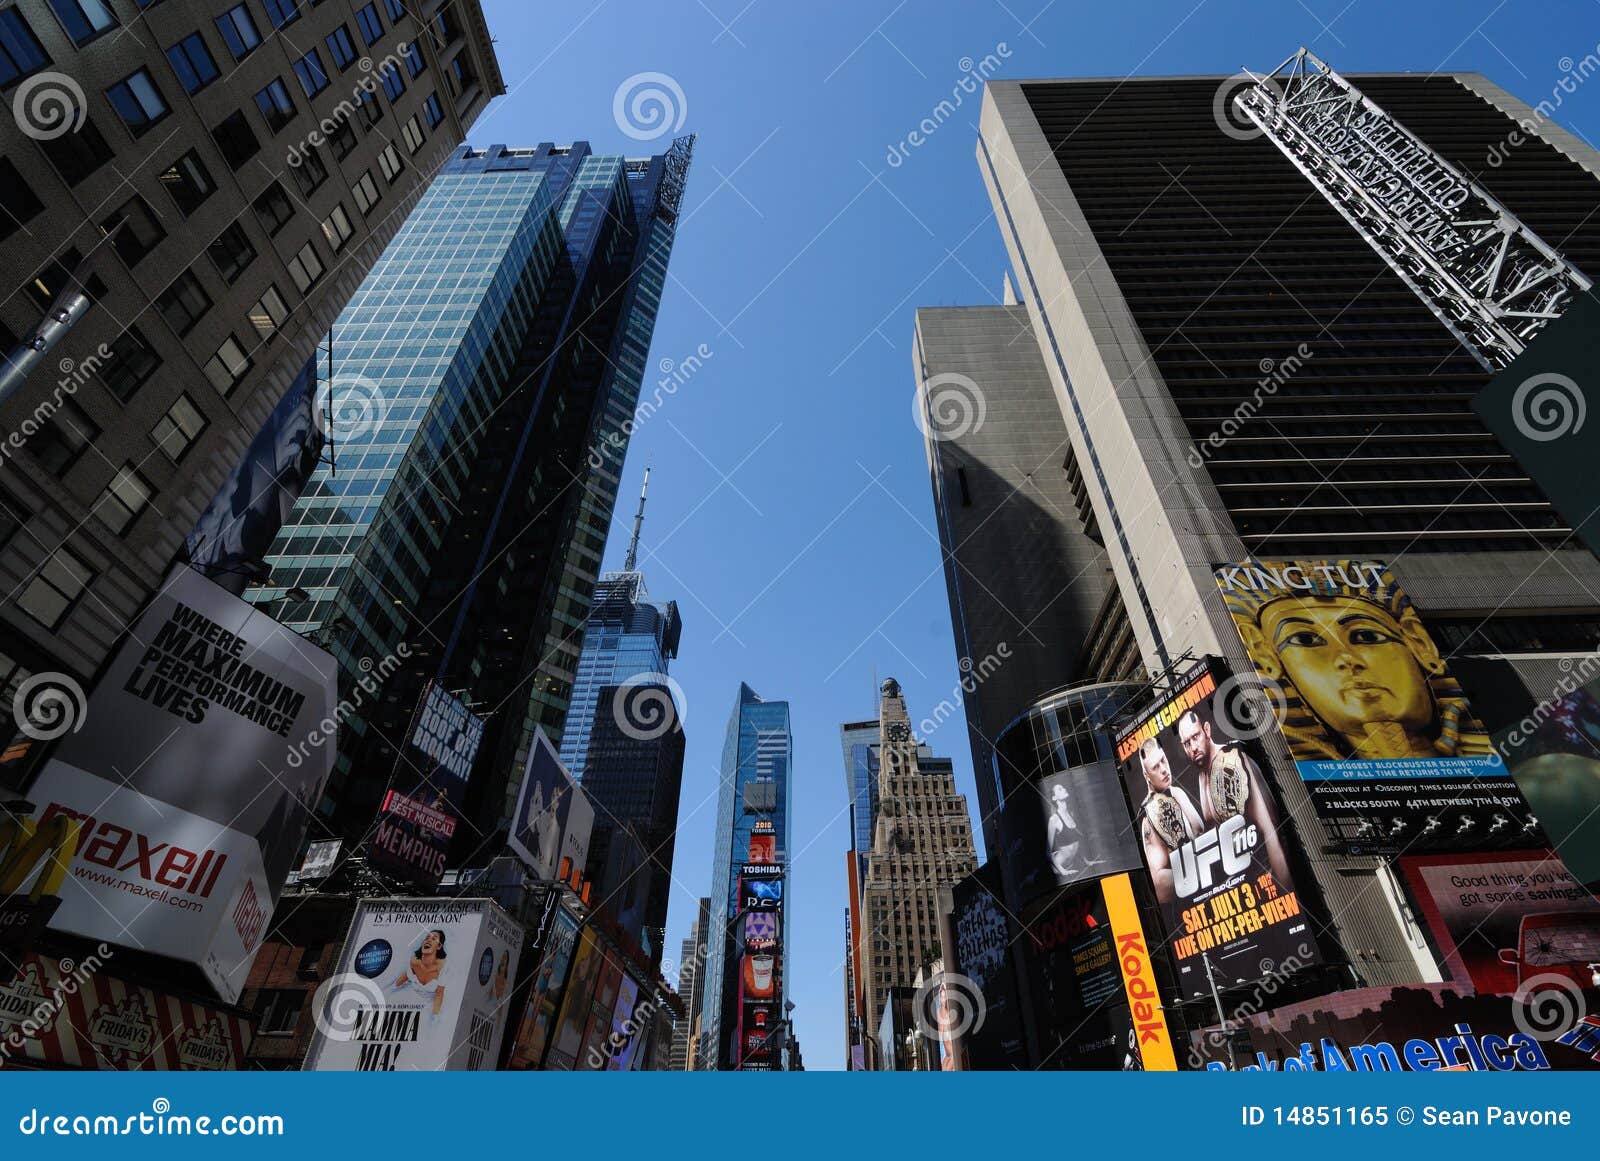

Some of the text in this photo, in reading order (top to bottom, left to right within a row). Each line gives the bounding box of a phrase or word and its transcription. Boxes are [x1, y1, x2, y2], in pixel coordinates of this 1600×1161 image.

[1352, 111, 1469, 210] OUTFITTERS
[1354, 152, 1466, 253] AMERICAN
[1220, 565, 1387, 591] KING TUT
[172, 602, 247, 657] WHERE
[141, 646, 294, 738] PERFORMANCE
[152, 620, 305, 719] MAXIMUM
[123, 666, 209, 724] LIVES
[426, 691, 466, 732] BLOWING
[465, 721, 486, 743] THE
[1117, 716, 1160, 763] LESNAR
[1160, 672, 1217, 728] CARWIN
[411, 726, 474, 782] BROADWAY!
[419, 705, 455, 743] ROOF
[454, 732, 480, 762] OFF
[1338, 762, 1375, 770] BIGGEST
[1375, 761, 1438, 770] BLOCKBUSTER
[1439, 760, 1489, 769] EXHIBITION
[1399, 769, 1441, 777] RETURNS
[1442, 768, 1453, 776] TO
[1455, 768, 1474, 776] NYC
[1442, 783, 1473, 791] SQUARE
[1473, 782, 1516, 791] EXPOSITION
[387, 800, 414, 821] BEST
[755, 821, 772, 829] 2010
[1326, 801, 1333, 809] 2
[1334, 801, 1369, 809] BLOCKS
[1370, 799, 1400, 808] SOUTH
[1406, 798, 1430, 810] 44TH
[1430, 797, 1473, 807] BETWEEN
[1473, 797, 1492, 809] 7TH
[1501, 796, 1521, 807] 8TH
[375, 821, 446, 877] MEMPHIS
[743, 865, 781, 874] TOSHIBA
[1169, 814, 1257, 899] UFC 116
[74, 865, 204, 913] www.maxell.com
[1451, 871, 1573, 888] Good thing you've
[1459, 891, 1483, 907] got
[1485, 890, 1525, 903] some
[366, 902, 387, 913] THIS
[441, 902, 482, 913] MUSICAL
[374, 914, 384, 924] IS
[386, 914, 393, 924] A
[1174, 933, 1200, 961] LIVE
[1195, 926, 1216, 952] ON
[1212, 891, 1301, 946] PAY-PER-VIEW
[1182, 883, 1257, 934] SAT. JULY 3
[1117, 932, 1164, 1044] Kodak
[97, 1019, 147, 1044] FRIDAY'S
[352, 1010, 421, 1042] MAMMA
[1320, 1023, 1552, 1071] America
[184, 1041, 225, 1062] FRIDAY'S
[356, 1043, 401, 1071] MIA!
